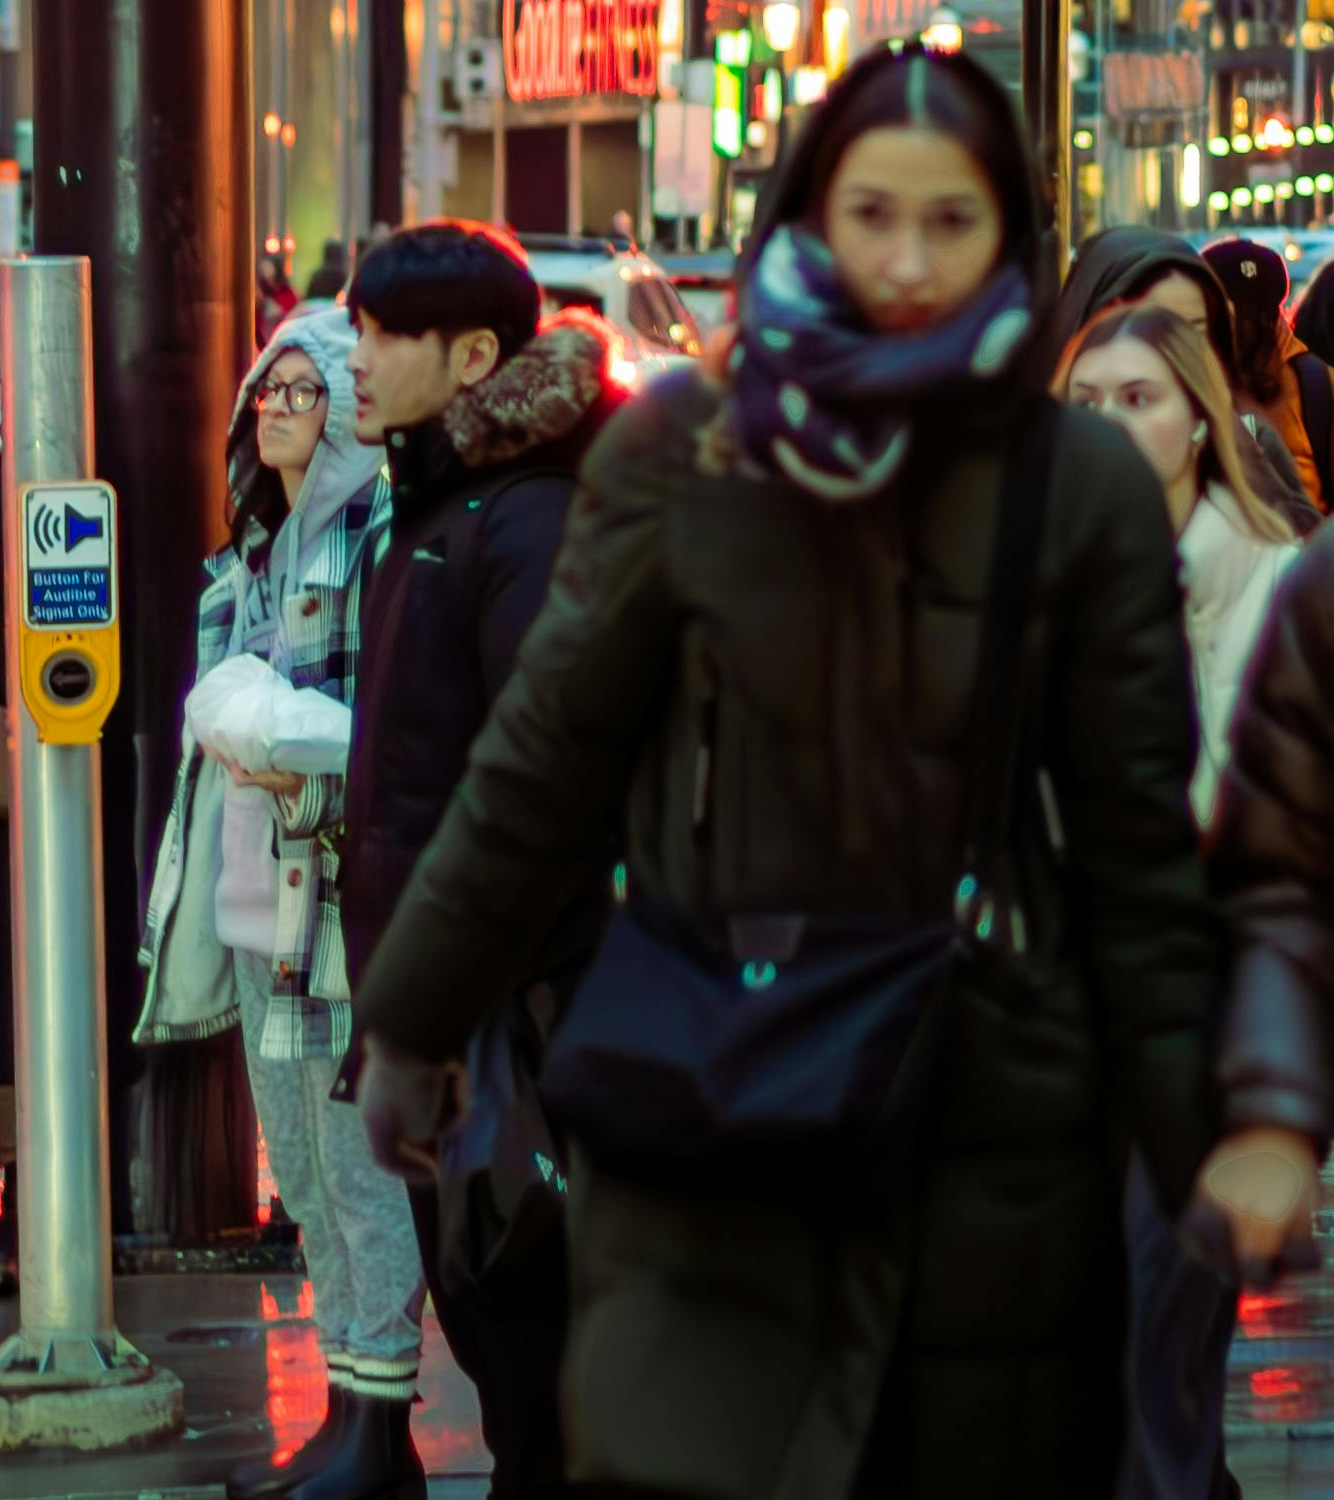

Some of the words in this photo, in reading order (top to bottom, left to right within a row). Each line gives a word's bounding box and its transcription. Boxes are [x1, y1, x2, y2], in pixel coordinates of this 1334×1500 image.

[33, 572, 80, 586] Button
[84, 570, 105, 585] For
[43, 588, 97, 602] Audible
[33, 604, 74, 622] Signal
[77, 603, 108, 620] Only
